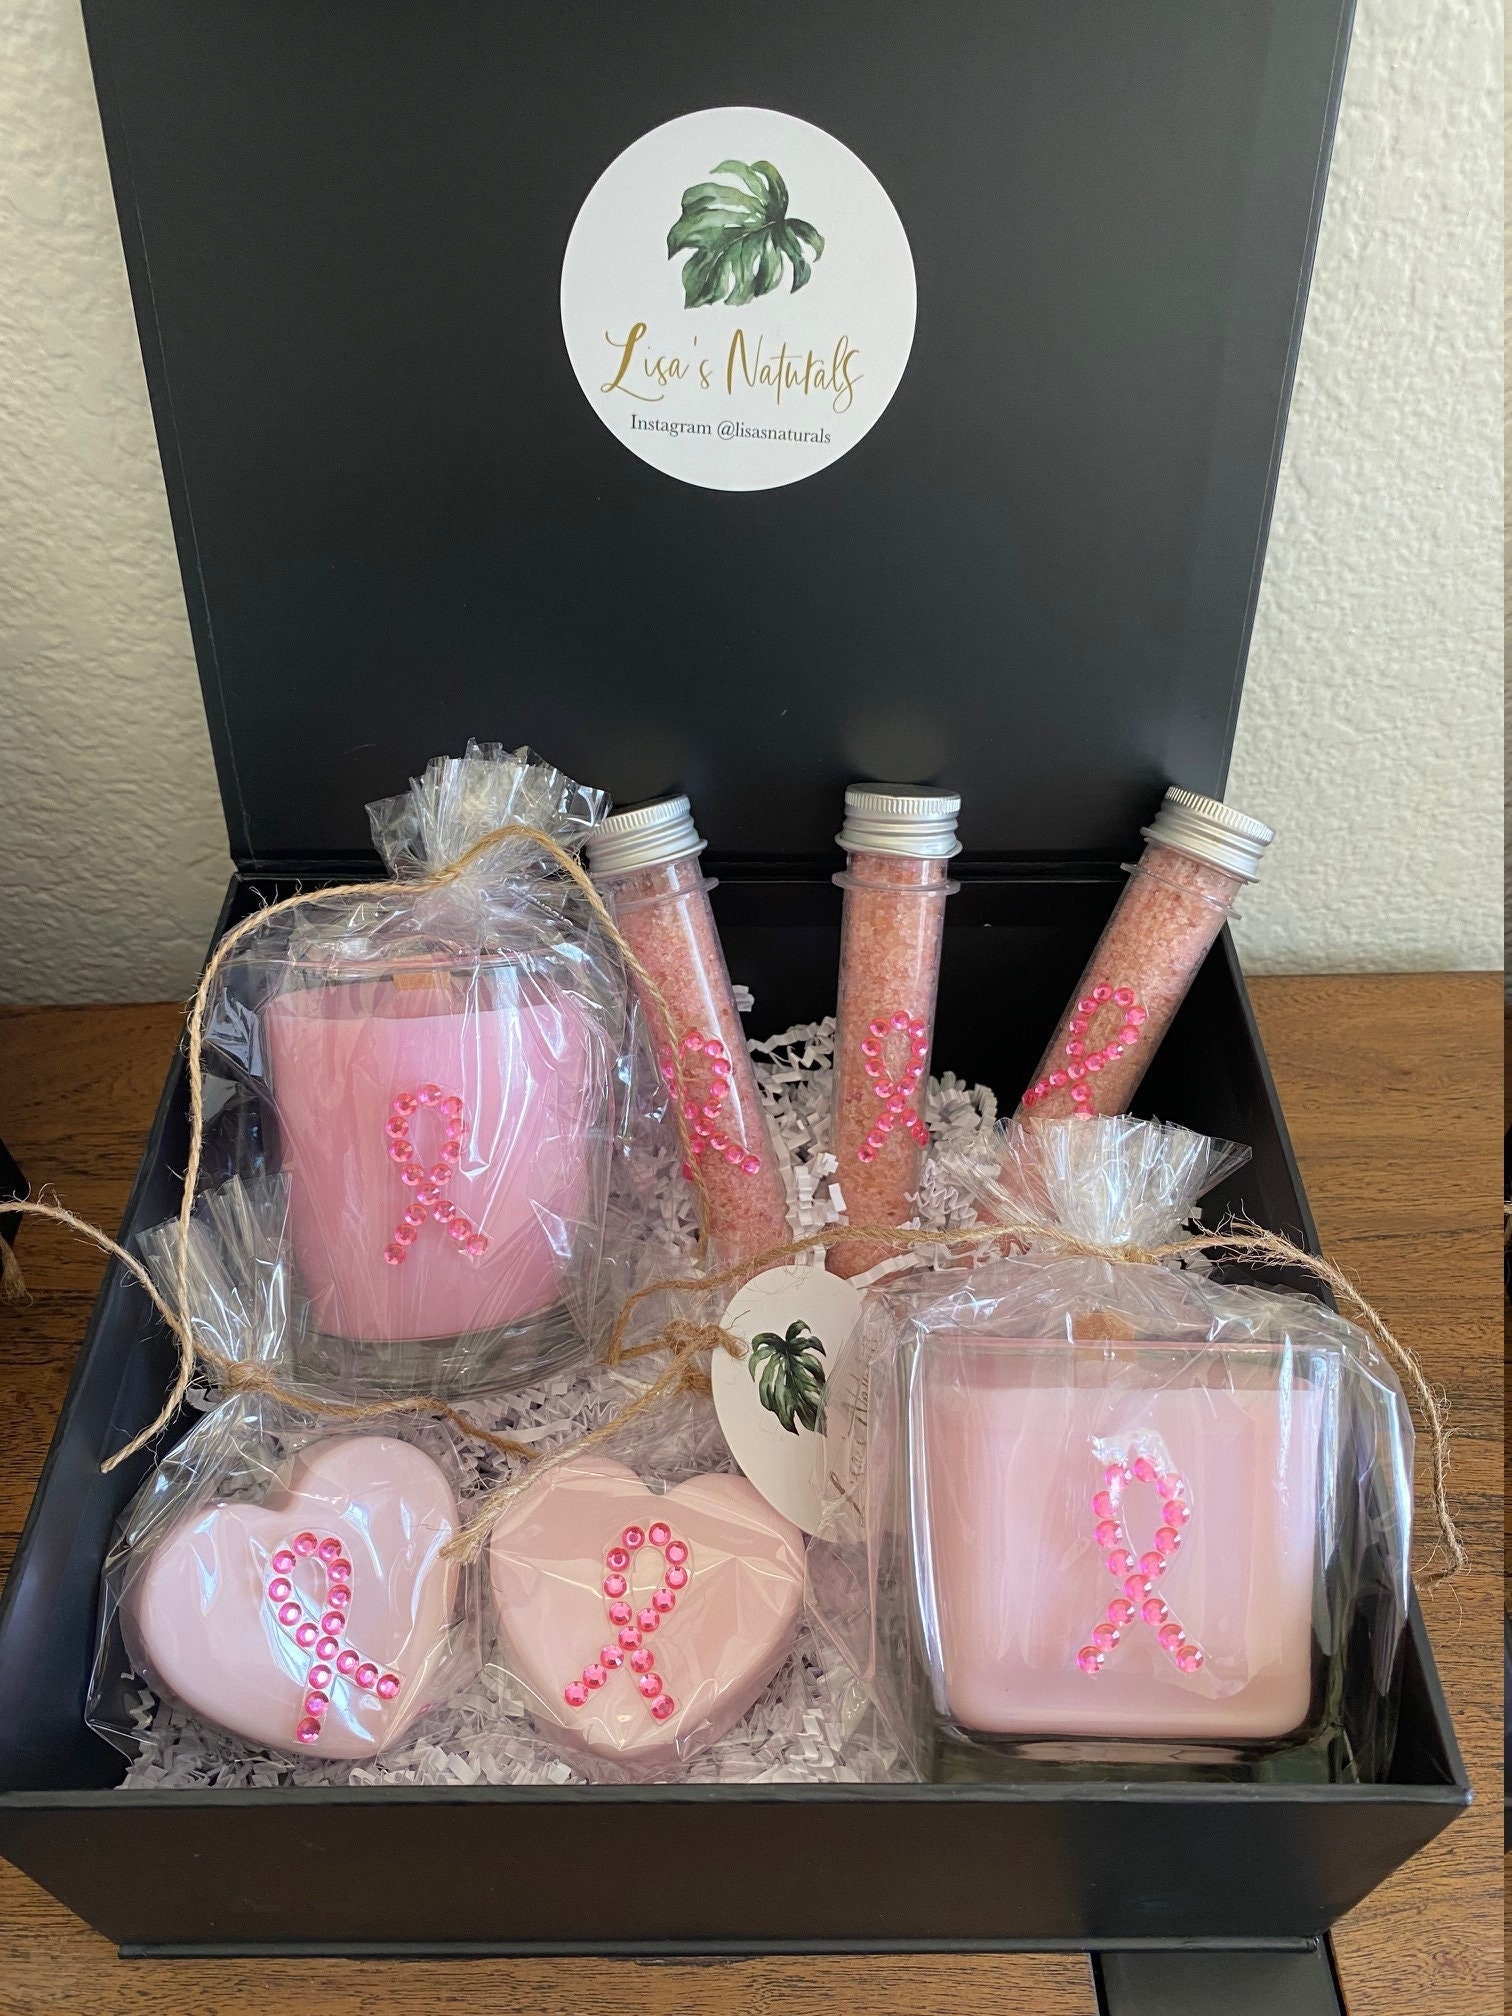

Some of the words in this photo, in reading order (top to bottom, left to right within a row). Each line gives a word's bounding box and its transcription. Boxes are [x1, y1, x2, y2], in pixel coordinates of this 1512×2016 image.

[601, 322, 713, 402] Lisa's
[725, 328, 864, 414] Naturals
[631, 414, 712, 437] Instagram
[717, 420, 832, 444] @lisasnaturals
